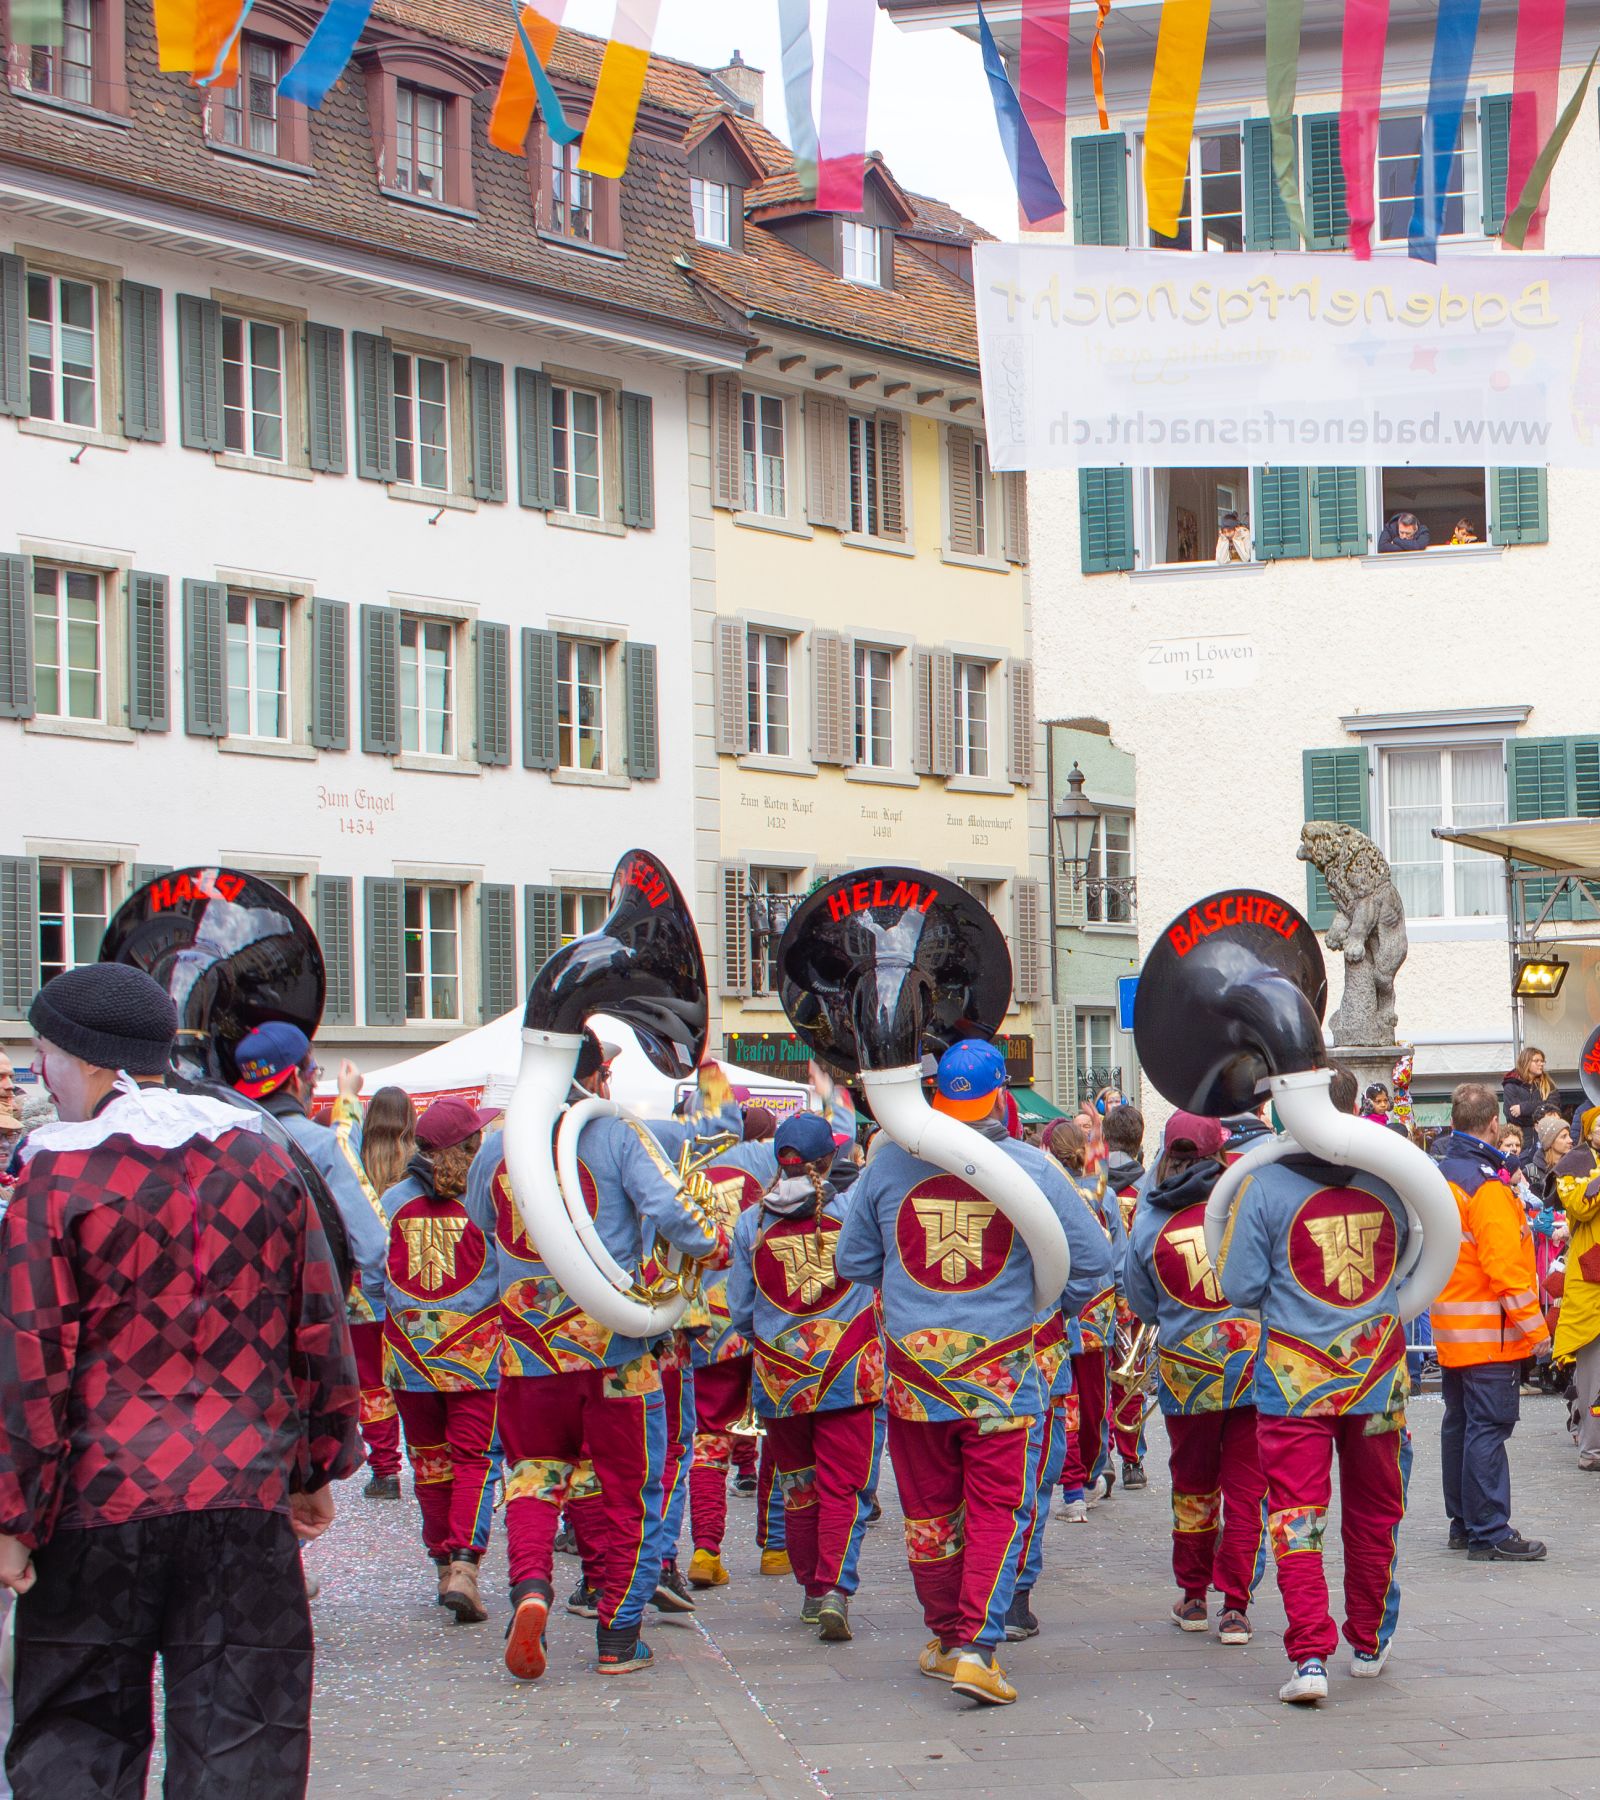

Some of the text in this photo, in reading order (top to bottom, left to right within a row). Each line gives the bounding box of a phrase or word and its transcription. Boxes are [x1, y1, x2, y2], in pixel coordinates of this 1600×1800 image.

[1148, 641, 1253, 664] Zum Löwen
[1185, 668, 1215, 685] 1512
[317, 785, 396, 815] Zum Engel
[740, 793, 814, 815] Zum Roten Kopf
[767, 816, 786, 830] 1432
[861, 805, 903, 824] Zum Kopf
[946, 813, 1013, 832] Zum Mohrenkopf
[340, 817, 375, 835] 1454
[827, 880, 938, 922] HELMI
[1168, 896, 1299, 957] BÄSCHTELI
[735, 1038, 775, 1062] Teatro
